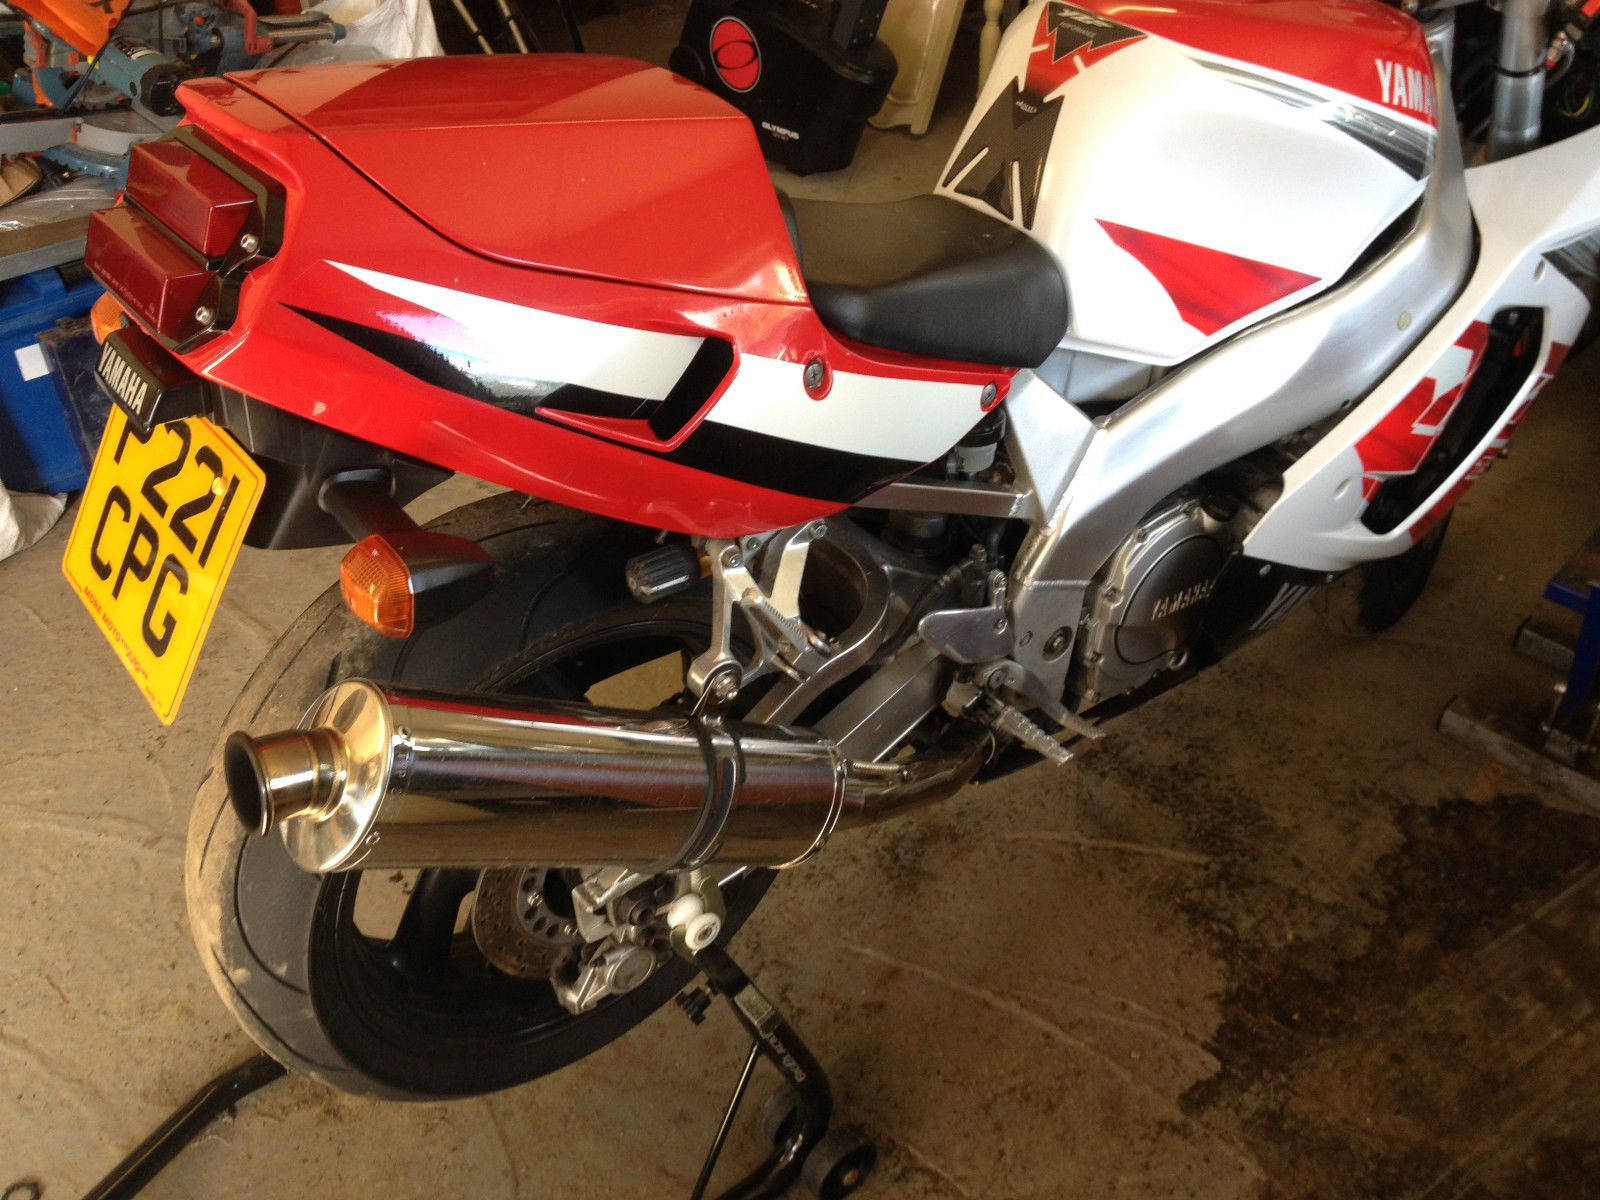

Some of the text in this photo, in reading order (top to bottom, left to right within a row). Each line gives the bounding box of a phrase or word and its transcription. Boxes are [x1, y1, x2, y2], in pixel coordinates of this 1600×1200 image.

[761, 120, 800, 140] OLYMPUS
[98, 341, 148, 415] YAMAHA
[91, 484, 189, 658] CPG
